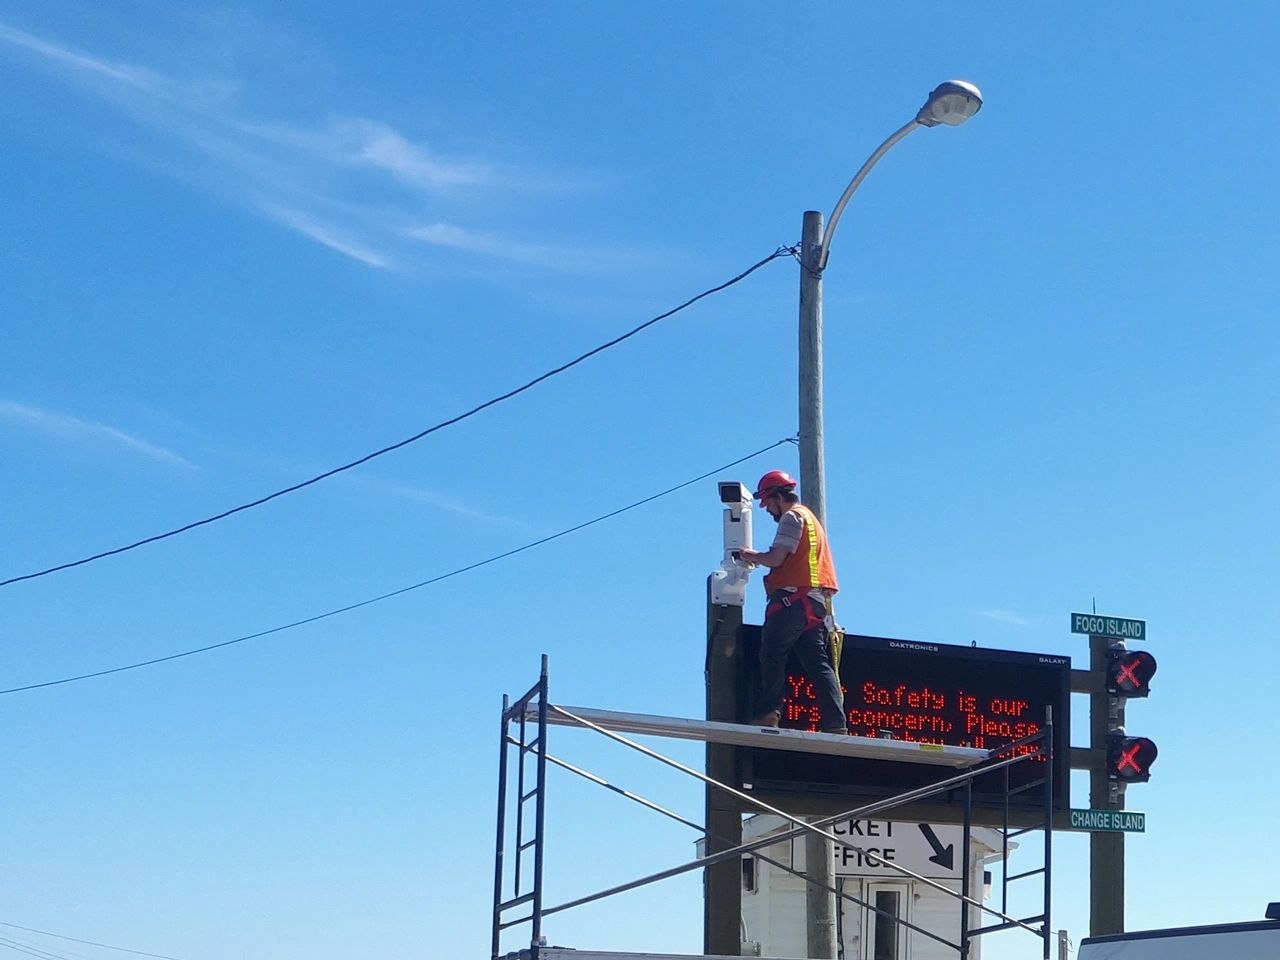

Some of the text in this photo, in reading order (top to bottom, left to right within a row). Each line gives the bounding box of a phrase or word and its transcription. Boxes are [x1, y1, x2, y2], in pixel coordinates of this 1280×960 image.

[1075, 615, 1142, 637] FOGO ISLAND
[889, 641, 939, 652] DAKTRONICS
[1038, 657, 1065, 665] GALAXY
[863, 681, 945, 711] Safety
[959, 690, 976, 713] is
[990, 698, 1029, 717] our
[967, 713, 1040, 739] Please
[1071, 811, 1144, 830] CHANGE ISLAND
